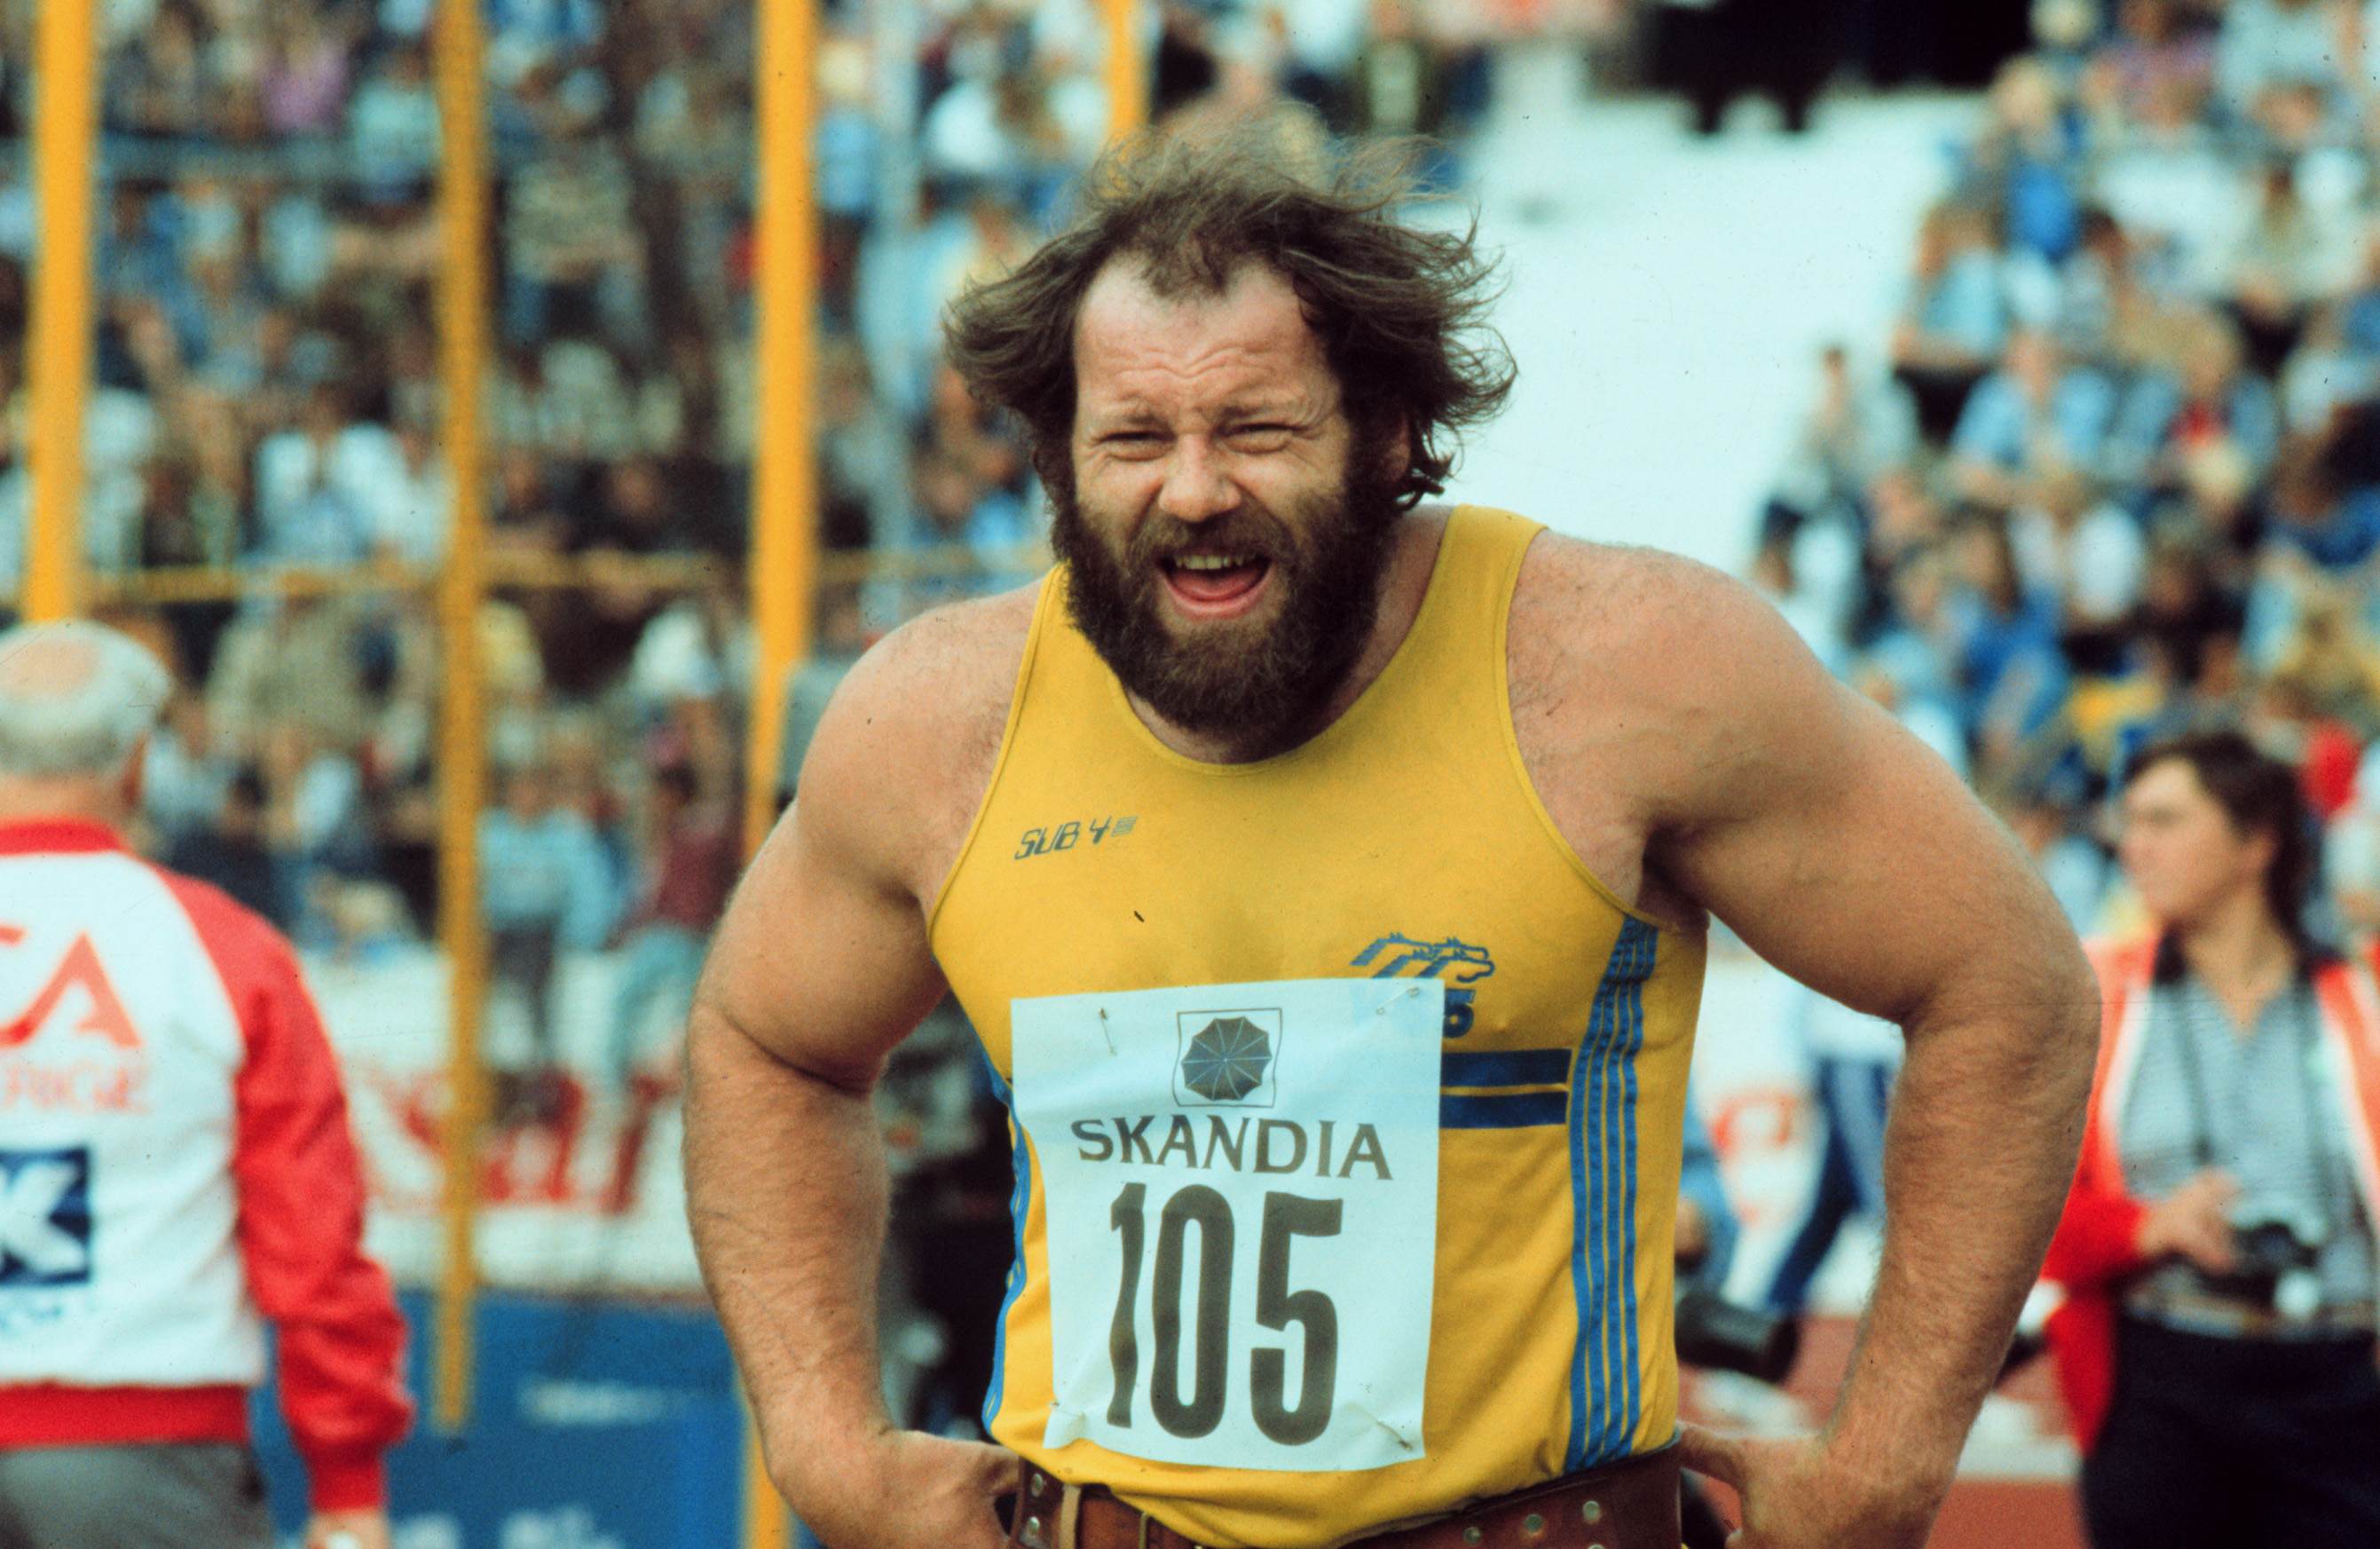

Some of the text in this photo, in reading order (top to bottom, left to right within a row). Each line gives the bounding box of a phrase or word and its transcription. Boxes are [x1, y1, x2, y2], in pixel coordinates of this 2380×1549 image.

[1013, 820, 1081, 860] SUB
[1069, 1115, 1394, 1181] SKANDIA
[1106, 1182, 1344, 1446] 105
